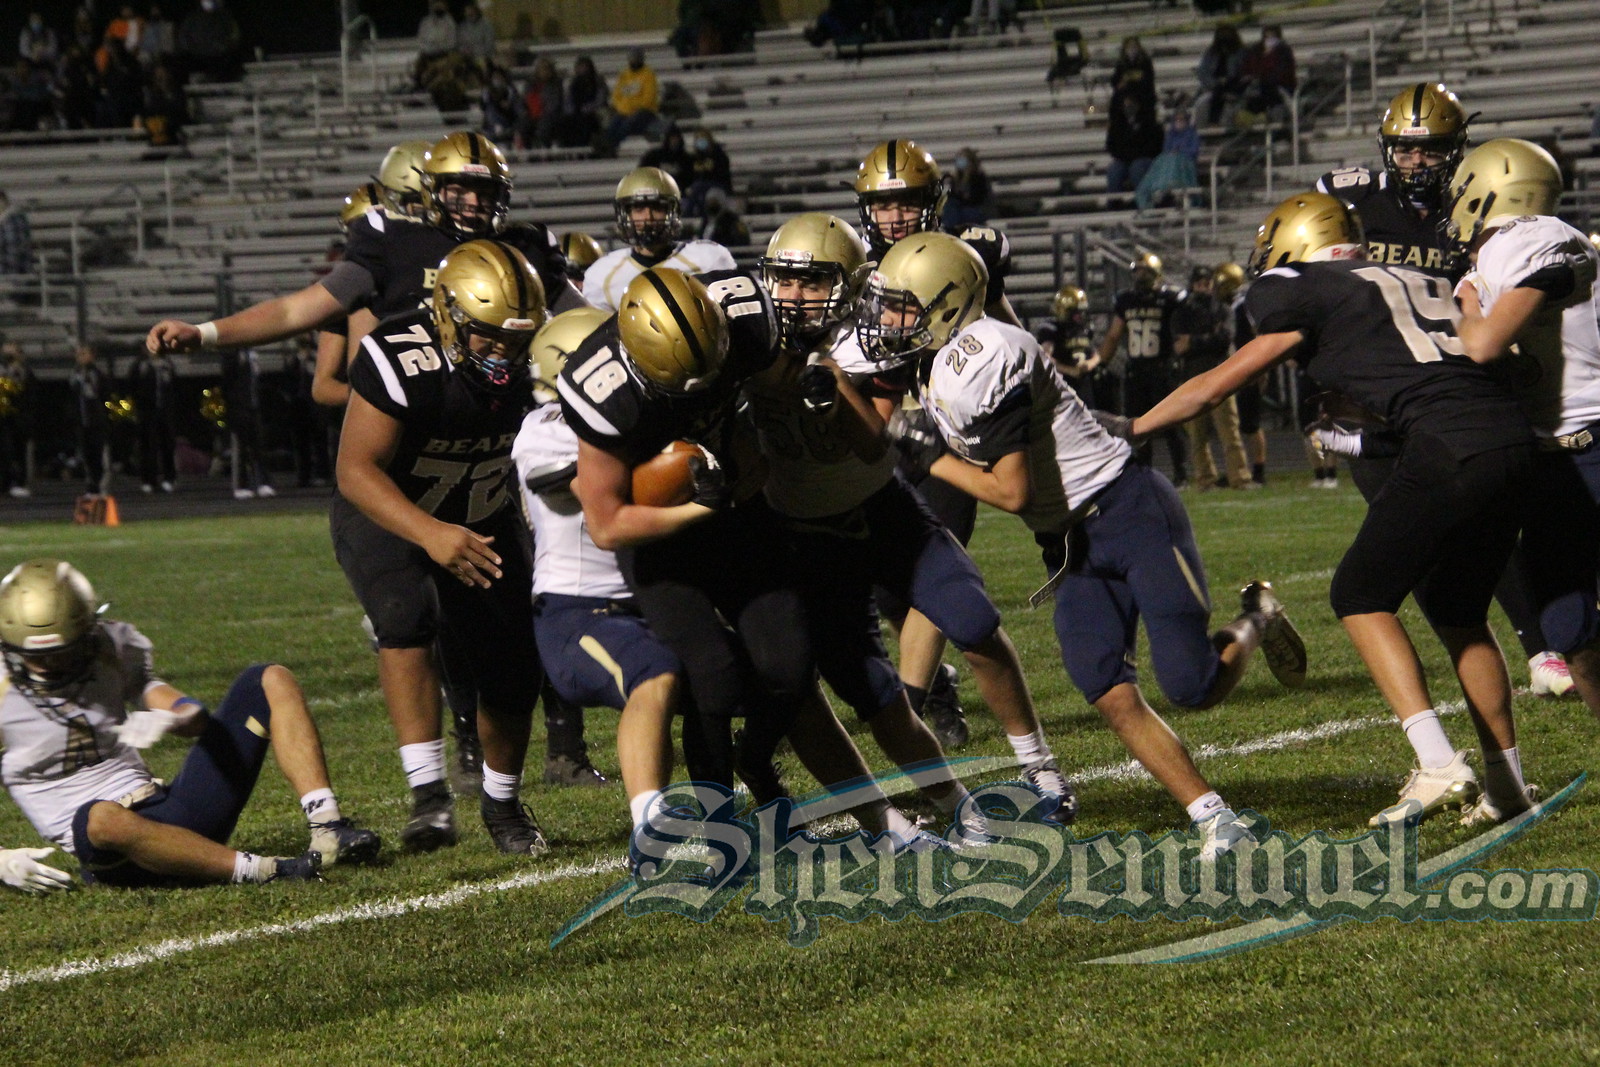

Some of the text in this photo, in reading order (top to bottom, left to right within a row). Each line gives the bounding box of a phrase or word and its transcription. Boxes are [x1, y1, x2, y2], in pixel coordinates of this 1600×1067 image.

[1350, 266, 1465, 363] 19
[383, 323, 442, 377] 72
[572, 345, 628, 404] 18
[945, 334, 984, 376] 28
[411, 456, 517, 524] 72
